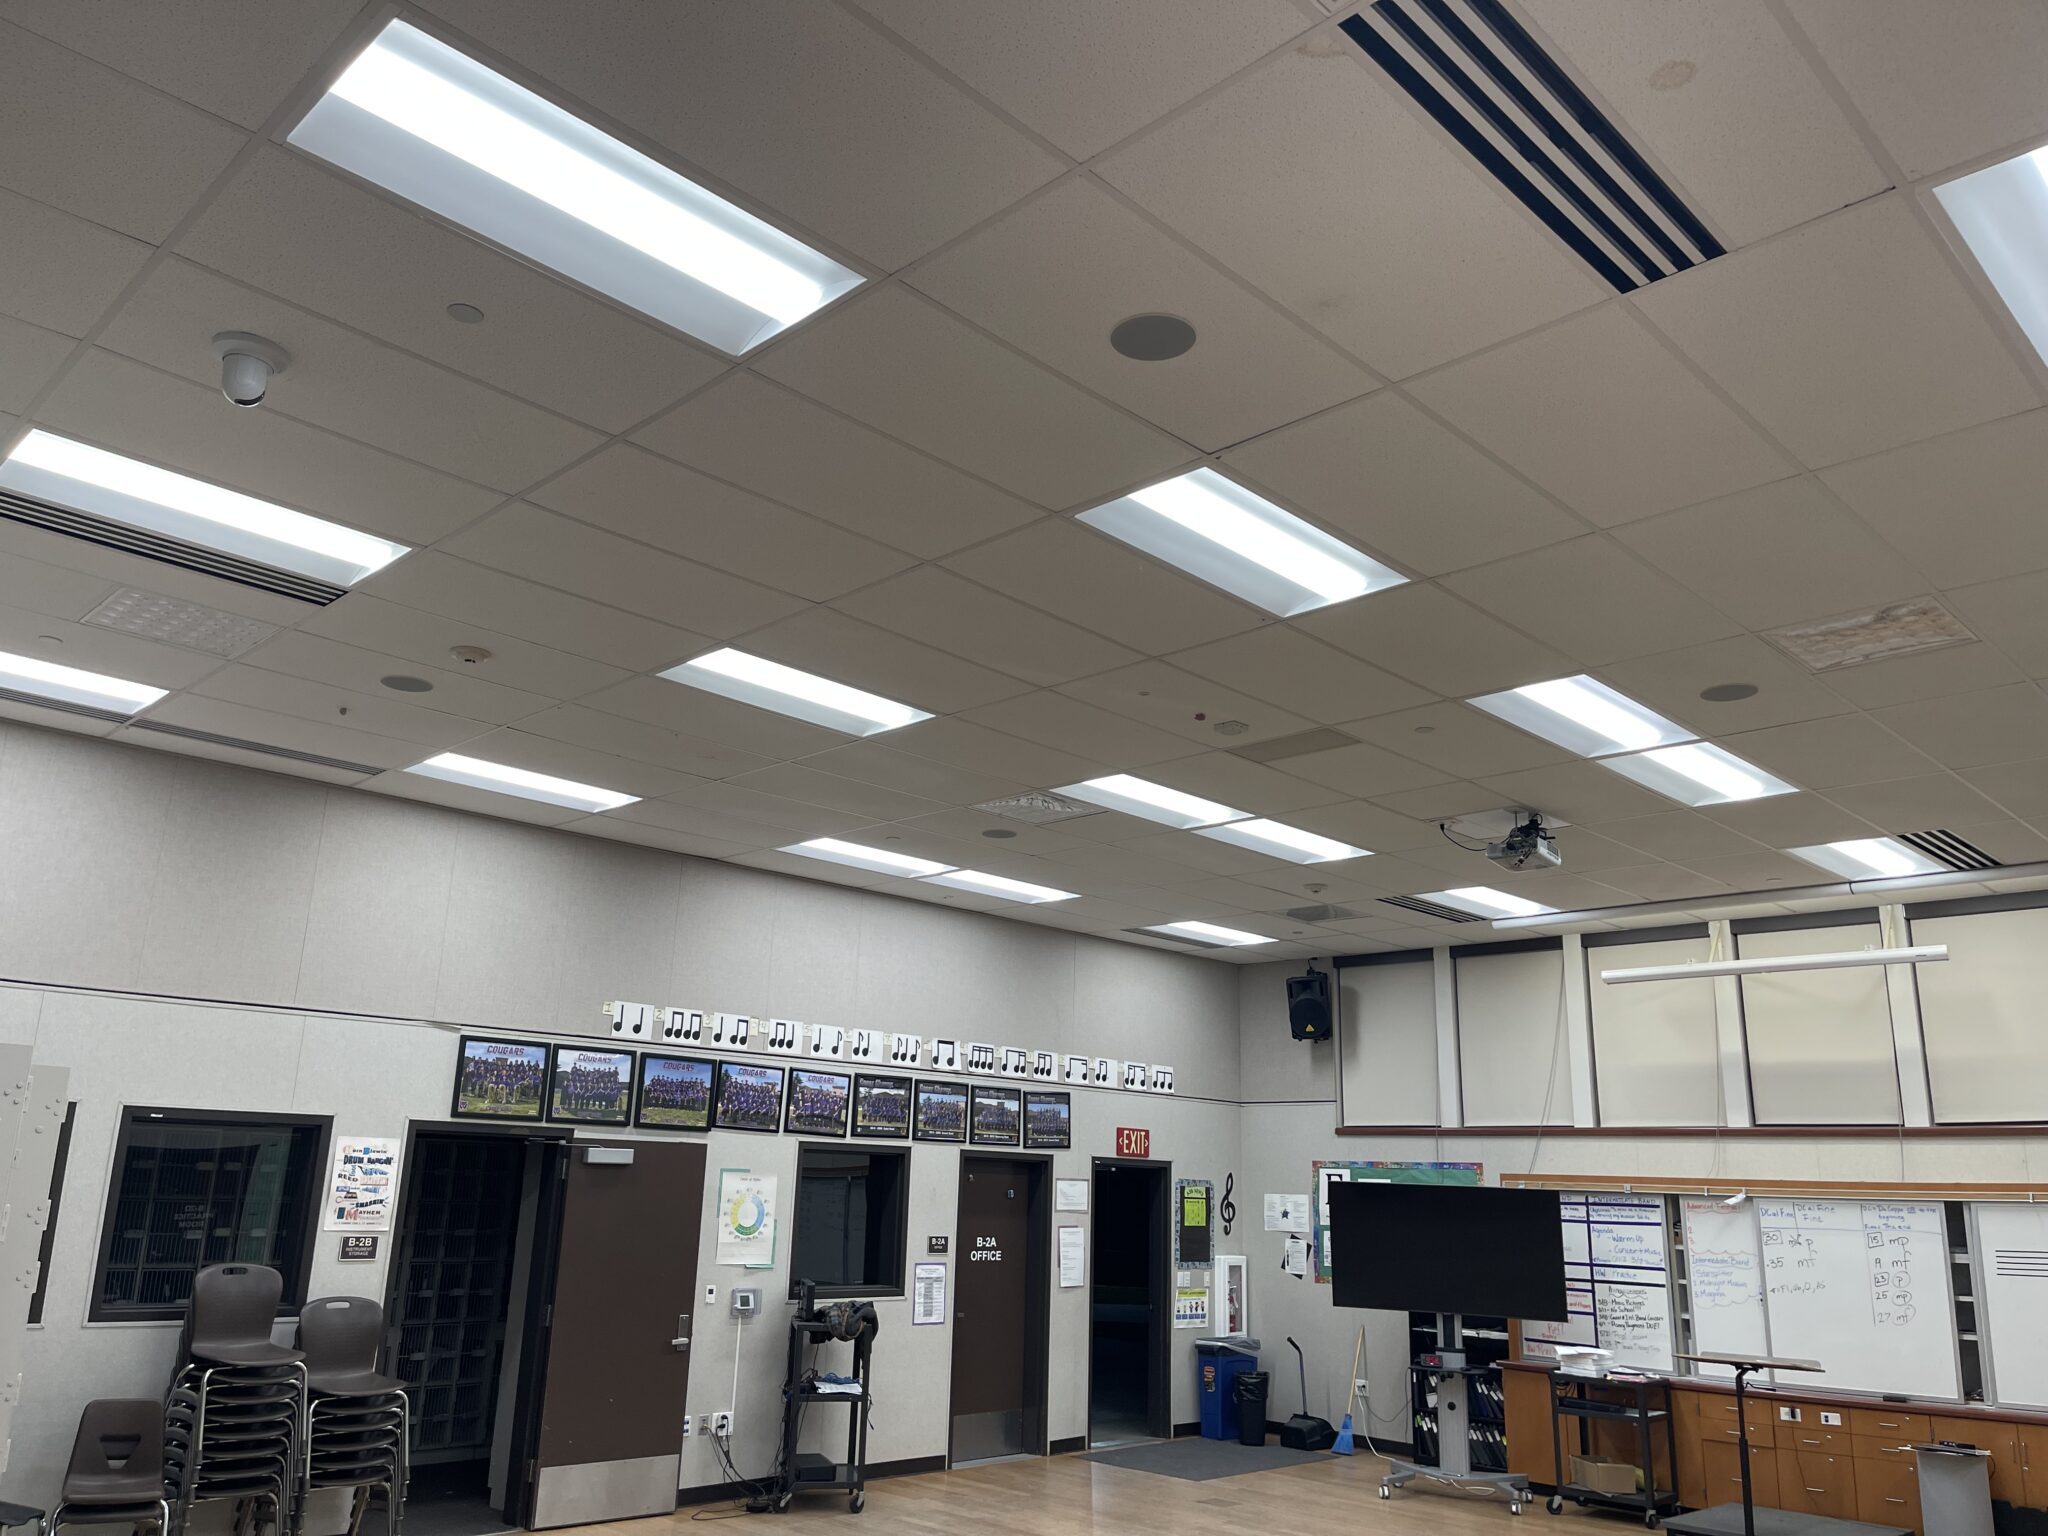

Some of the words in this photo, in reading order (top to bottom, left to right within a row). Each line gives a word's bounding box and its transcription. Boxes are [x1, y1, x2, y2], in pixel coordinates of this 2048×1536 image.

[487, 1045, 525, 1056] COUGARS
[577, 1053, 613, 1064] COUGARS
[663, 1061, 695, 1072] COUGARS
[738, 1067, 768, 1078] COUGARS
[807, 1074, 835, 1085] COUGARS
[1123, 1130, 1146, 1154] EXIT
[343, 1155, 365, 1165] DRUM
[337, 1173, 359, 1182] REED
[348, 1237, 372, 1247] B-2B
[976, 1237, 997, 1247] B-2A
[970, 1250, 1002, 1261] OFFICE
